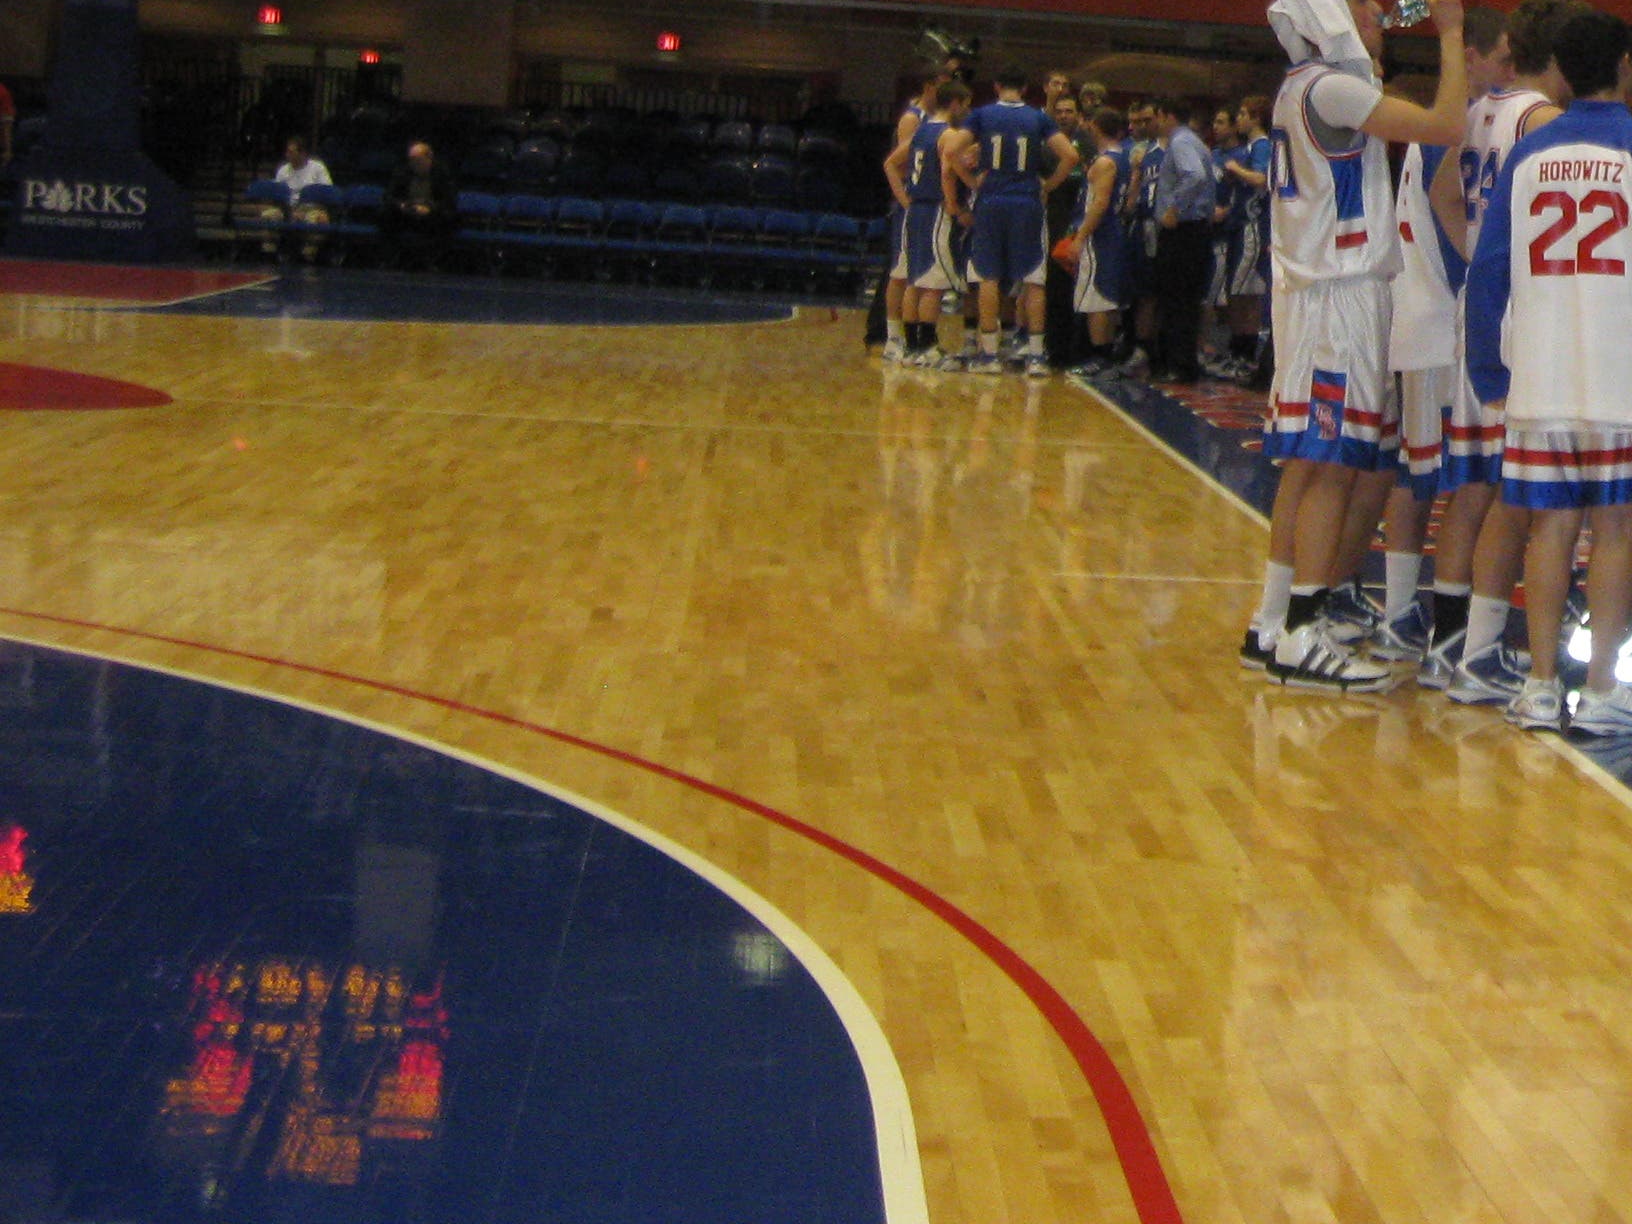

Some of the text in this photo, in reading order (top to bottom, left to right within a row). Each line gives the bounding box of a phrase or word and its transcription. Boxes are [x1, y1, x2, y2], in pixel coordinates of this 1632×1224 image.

[910, 149, 925, 185] 5
[989, 134, 1030, 173] 11
[1538, 157, 1624, 184] HOROWITZ
[22, 179, 148, 216] PARKS
[1528, 190, 1630, 277] 22
